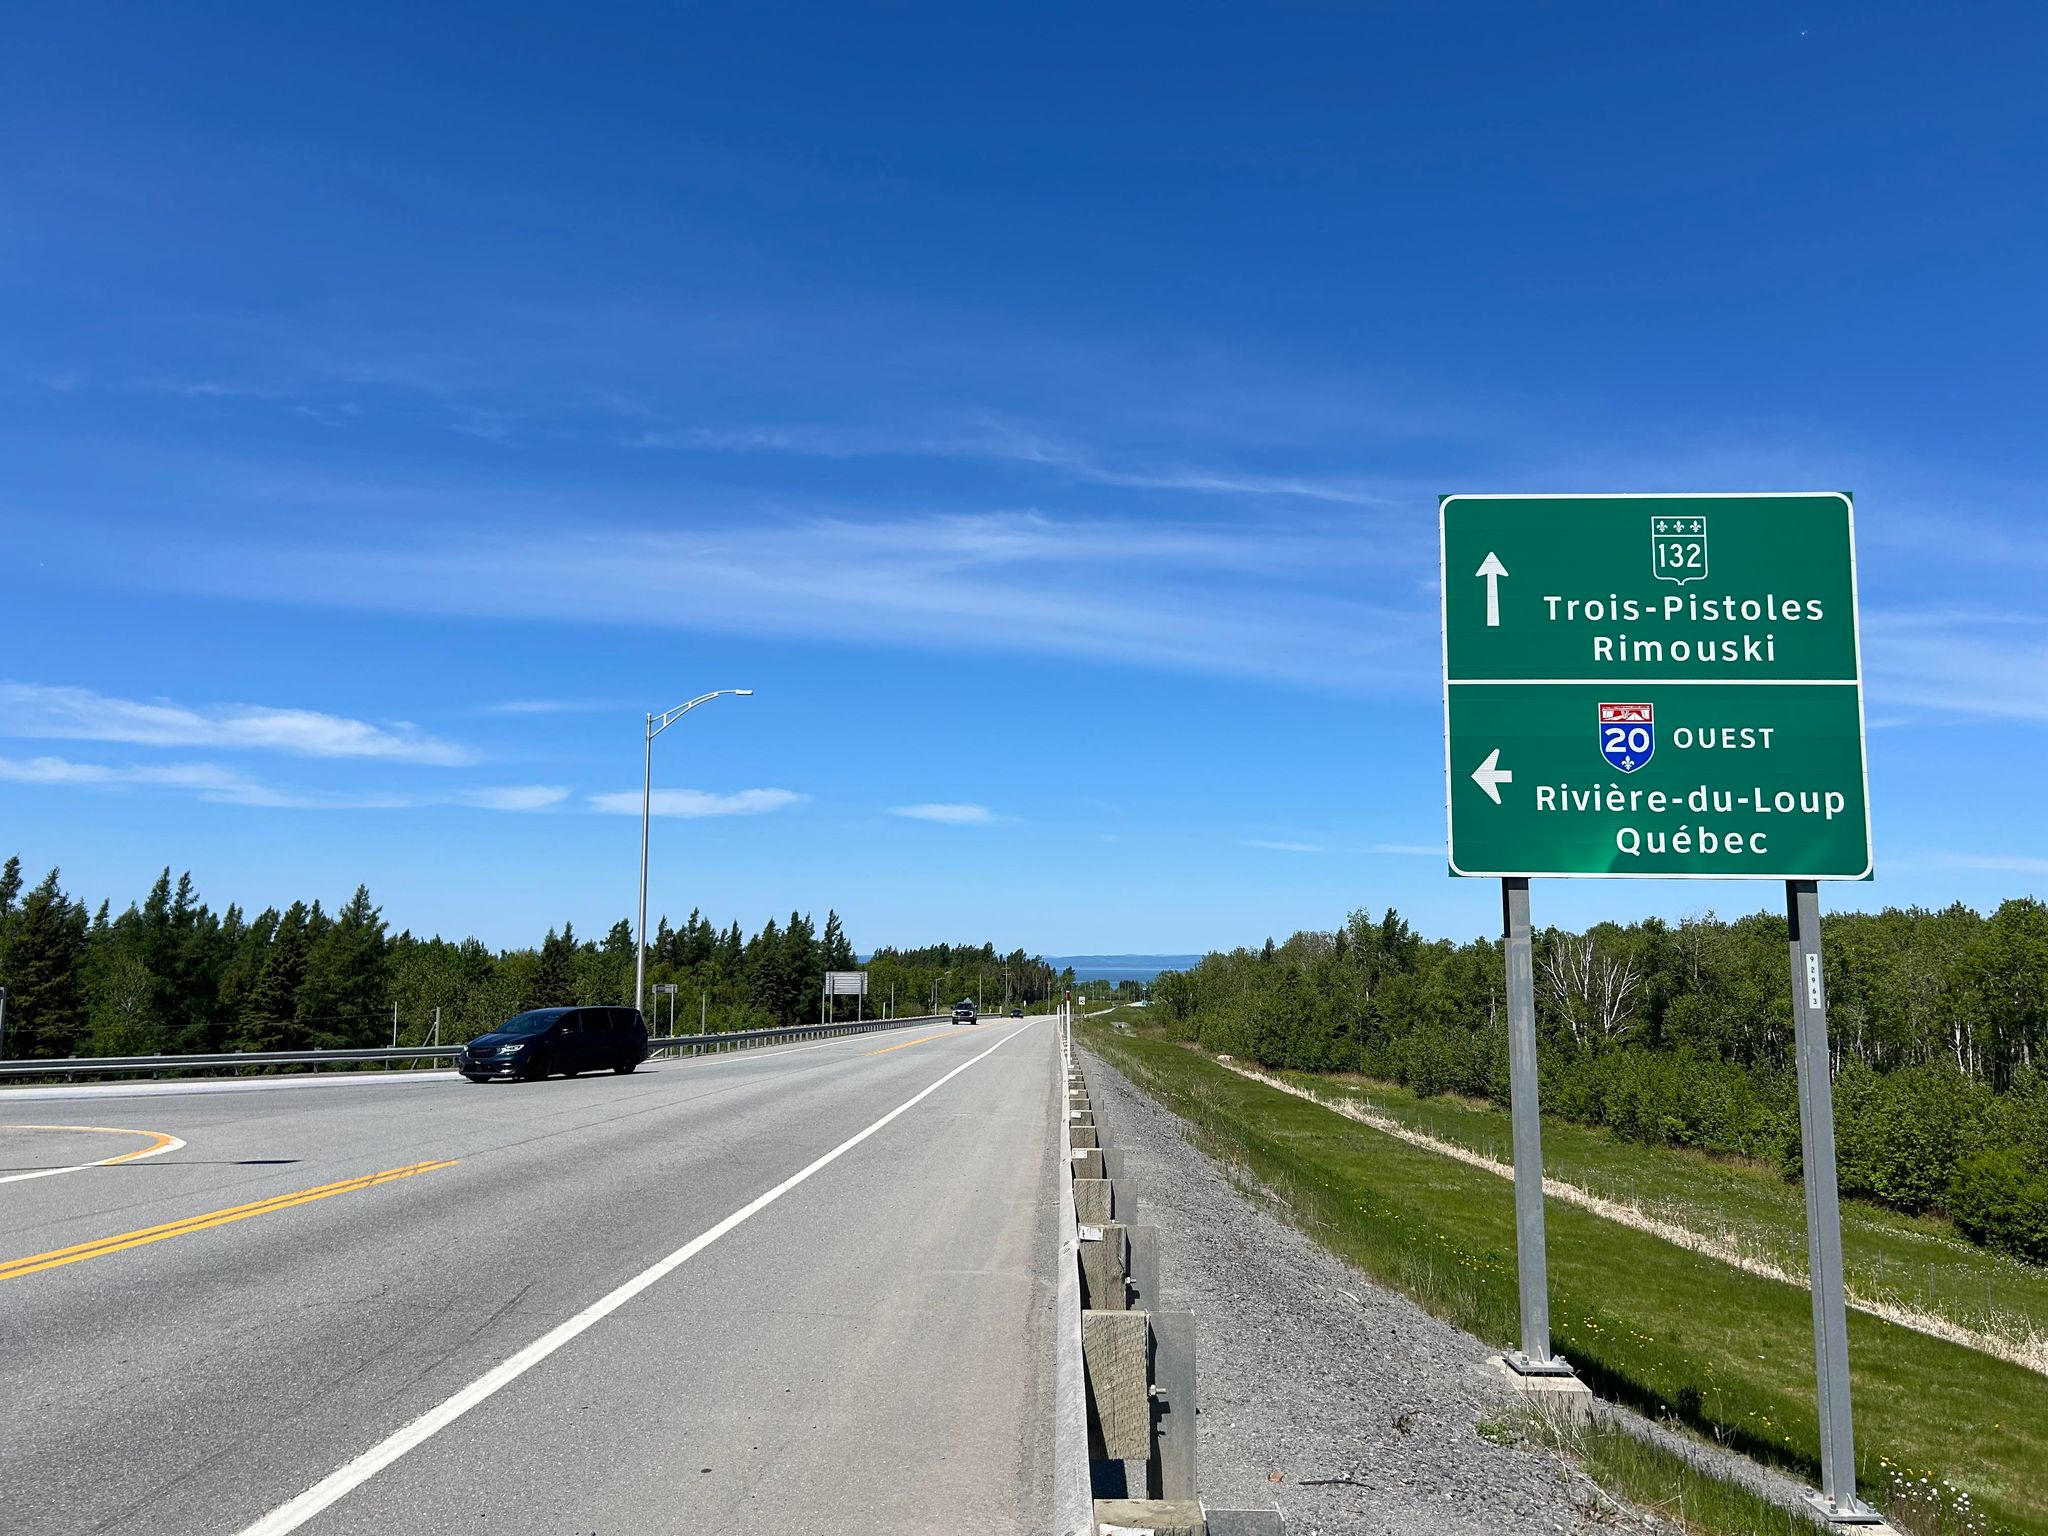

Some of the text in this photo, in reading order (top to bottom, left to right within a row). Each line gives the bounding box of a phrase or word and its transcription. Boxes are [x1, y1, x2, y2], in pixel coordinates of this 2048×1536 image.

[1659, 544, 1701, 568] 132
[1543, 593, 1824, 621] Trois-Pistoles
[1593, 633, 1775, 662] Rimouski
[1605, 727, 1774, 753] 20 OUEST
[1536, 783, 1845, 820] Rivière-du-Loup
[1616, 825, 1768, 857] Québec
[1809, 956, 1818, 1005] 92963
